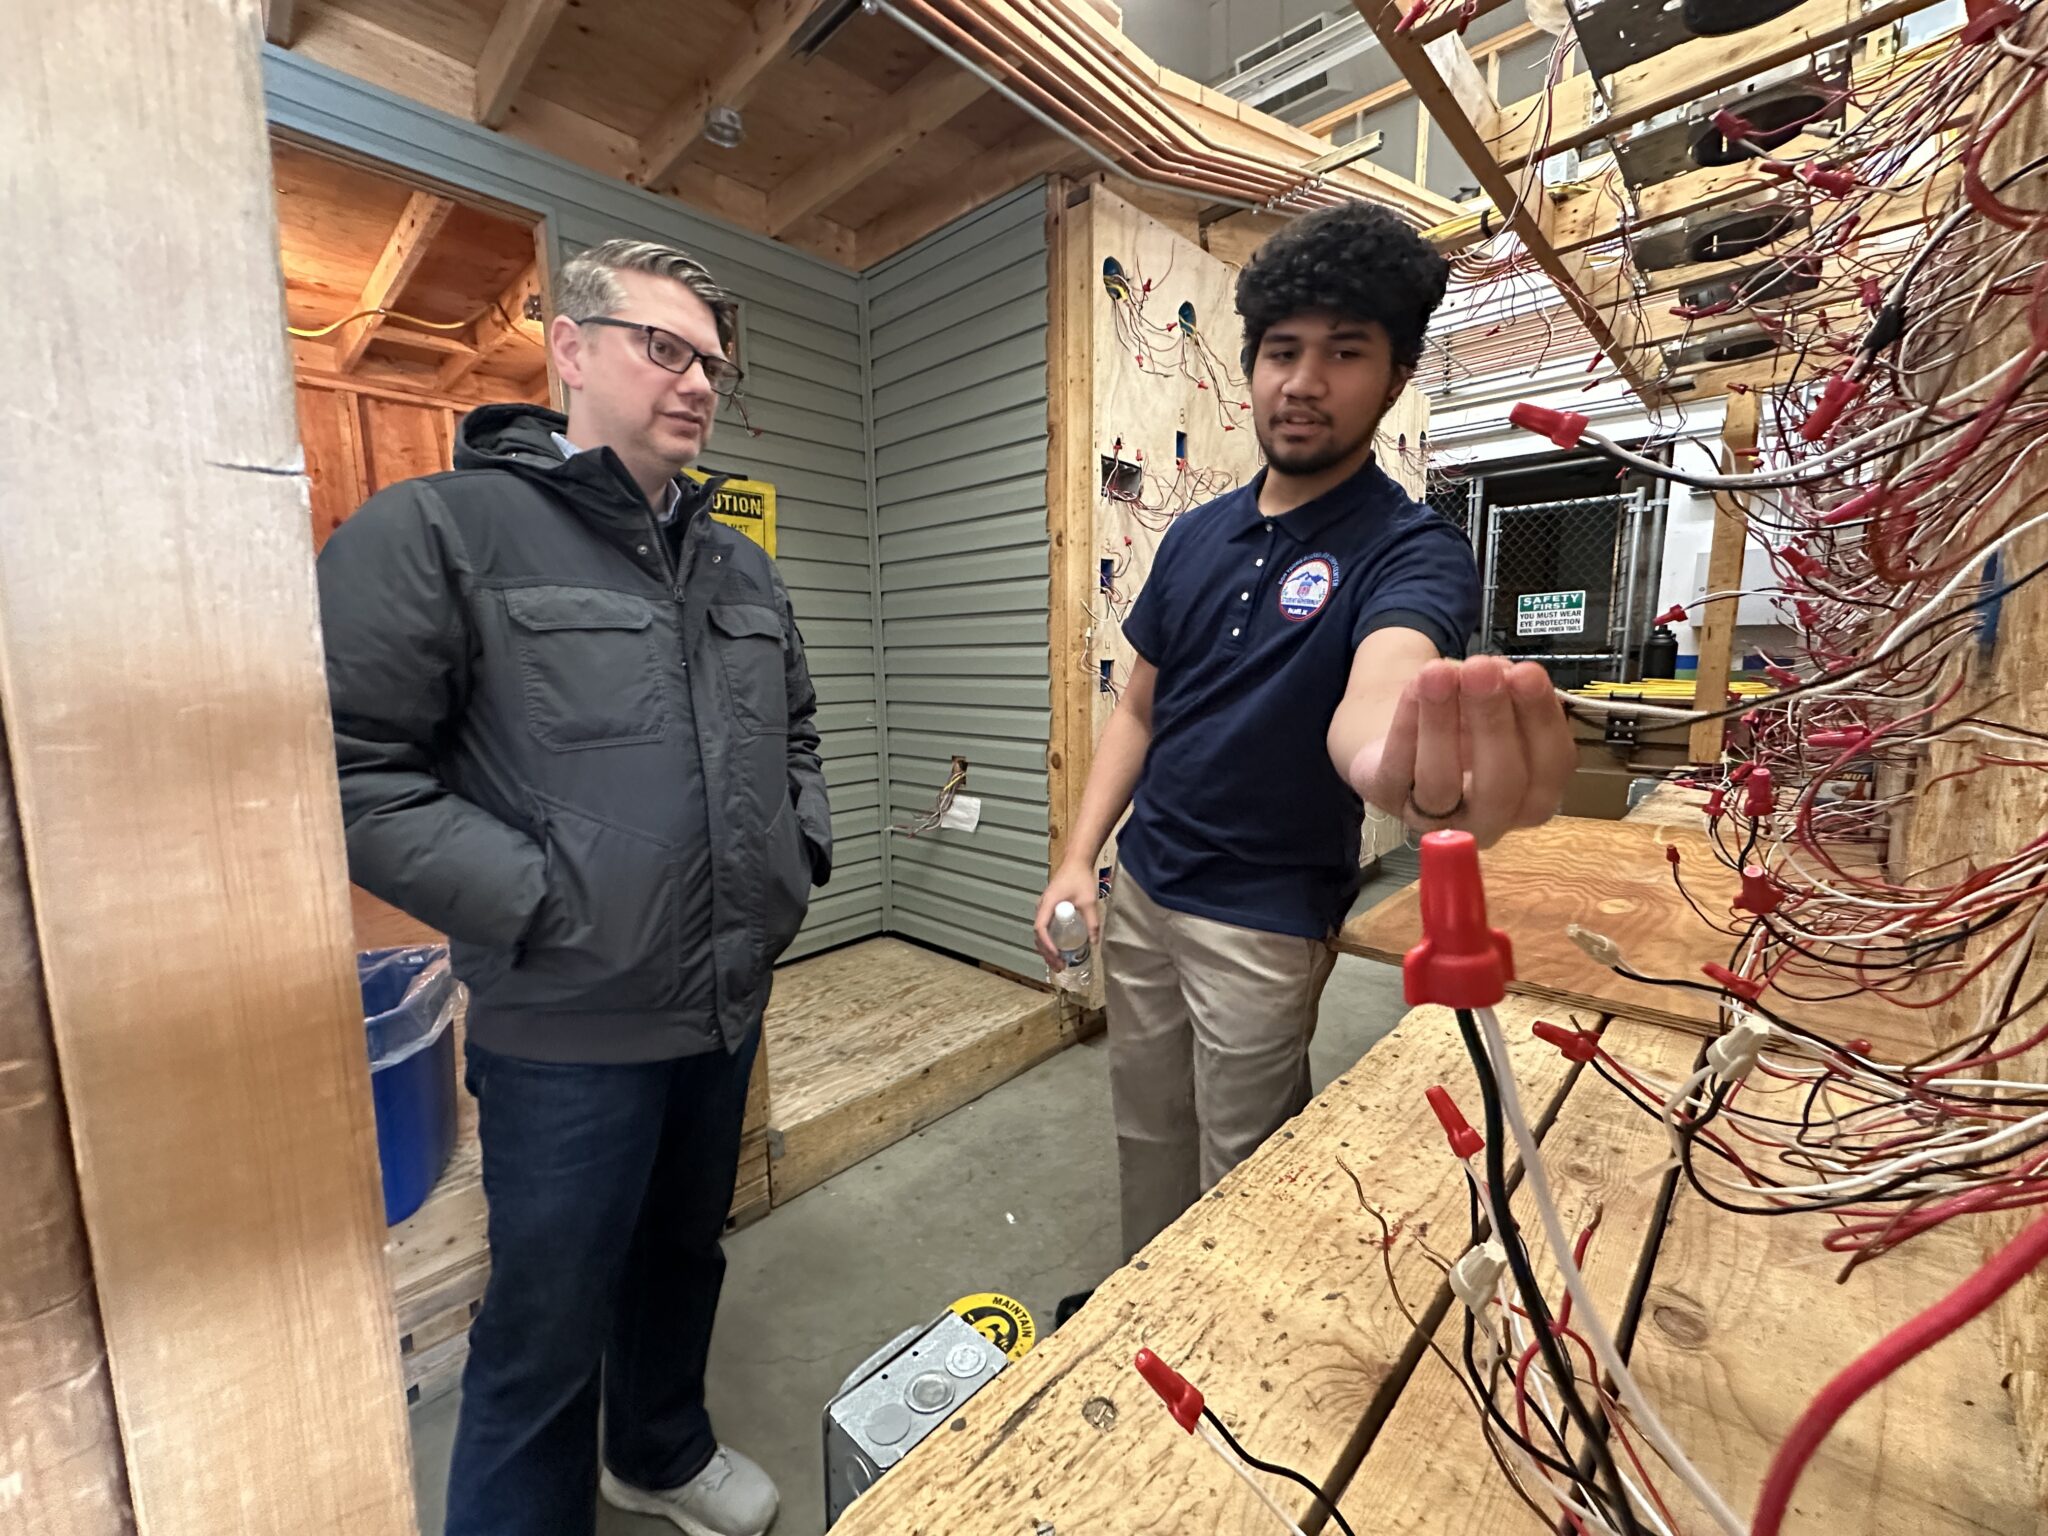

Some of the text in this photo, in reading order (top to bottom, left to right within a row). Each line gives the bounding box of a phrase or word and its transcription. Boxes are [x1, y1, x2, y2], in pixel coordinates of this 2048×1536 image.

[713, 493, 761, 516] UTION
[1523, 593, 1580, 607] SAFETY
[1533, 602, 1568, 610] FIRST
[1520, 612, 1534, 620] YOU
[1537, 611, 1558, 619] MUST
[1535, 619, 1581, 627] PROTECTION
[992, 1296, 1033, 1338] MAINTAIN
